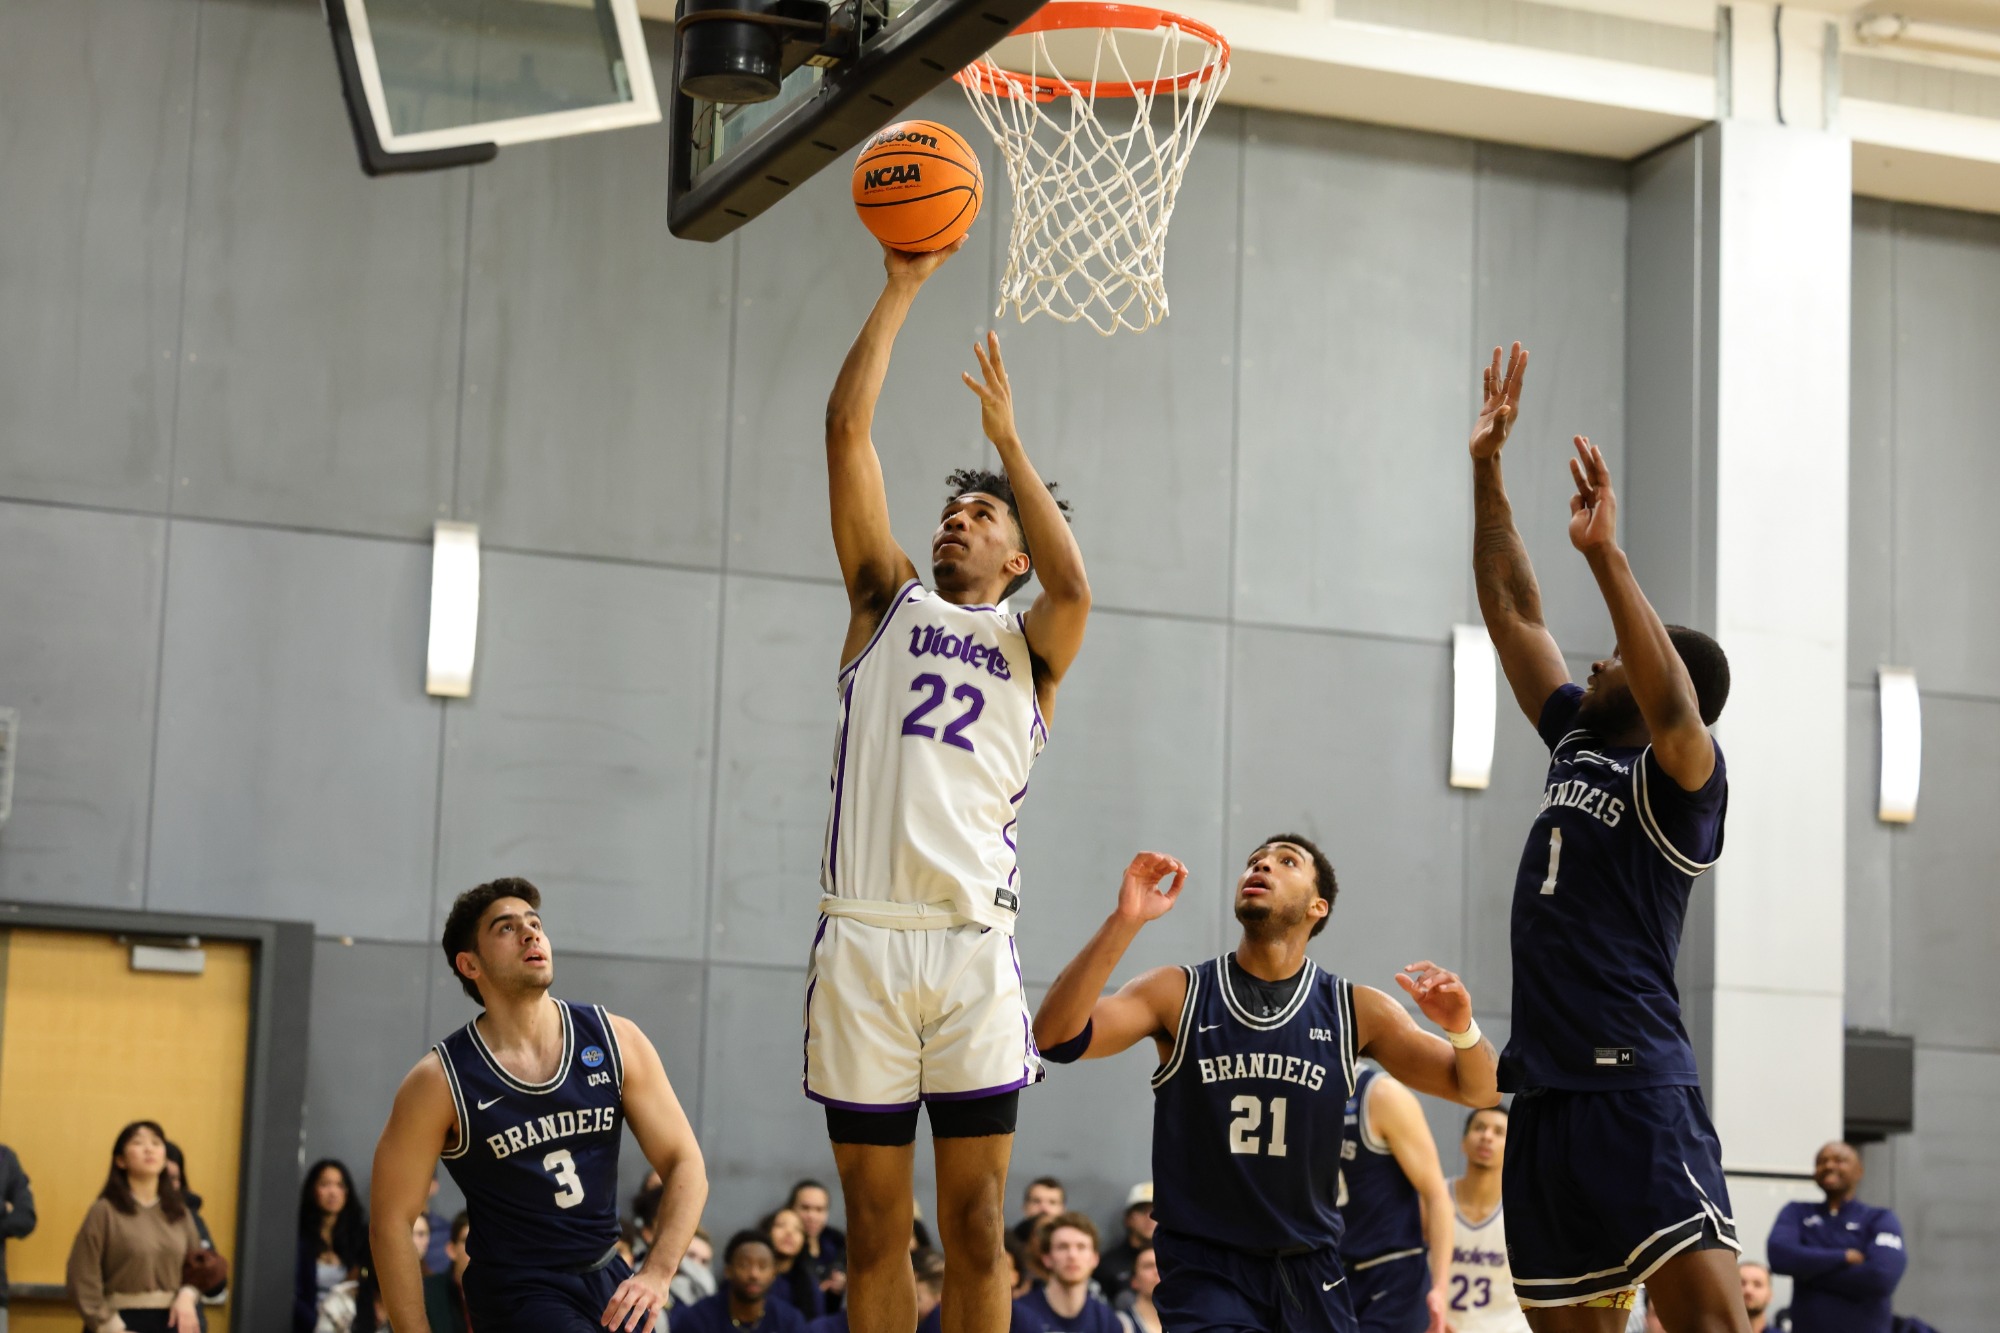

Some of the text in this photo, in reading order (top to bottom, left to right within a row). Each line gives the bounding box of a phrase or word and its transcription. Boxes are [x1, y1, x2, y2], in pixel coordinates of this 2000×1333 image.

[864, 163, 921, 190] NCAA
[909, 623, 1012, 681] Violets
[901, 672, 985, 753] 22
[1540, 827, 1562, 895] 1
[1309, 1028, 1332, 1042] UAA
[1621, 1052, 1630, 1061] M
[587, 1071, 612, 1087] UAA
[1198, 1053, 1327, 1091] BRANDEIS
[486, 1106, 615, 1159] BRANDEIS
[1230, 1095, 1287, 1156] 21
[543, 1149, 585, 1209] 3
[1450, 1274, 1491, 1311] 23
